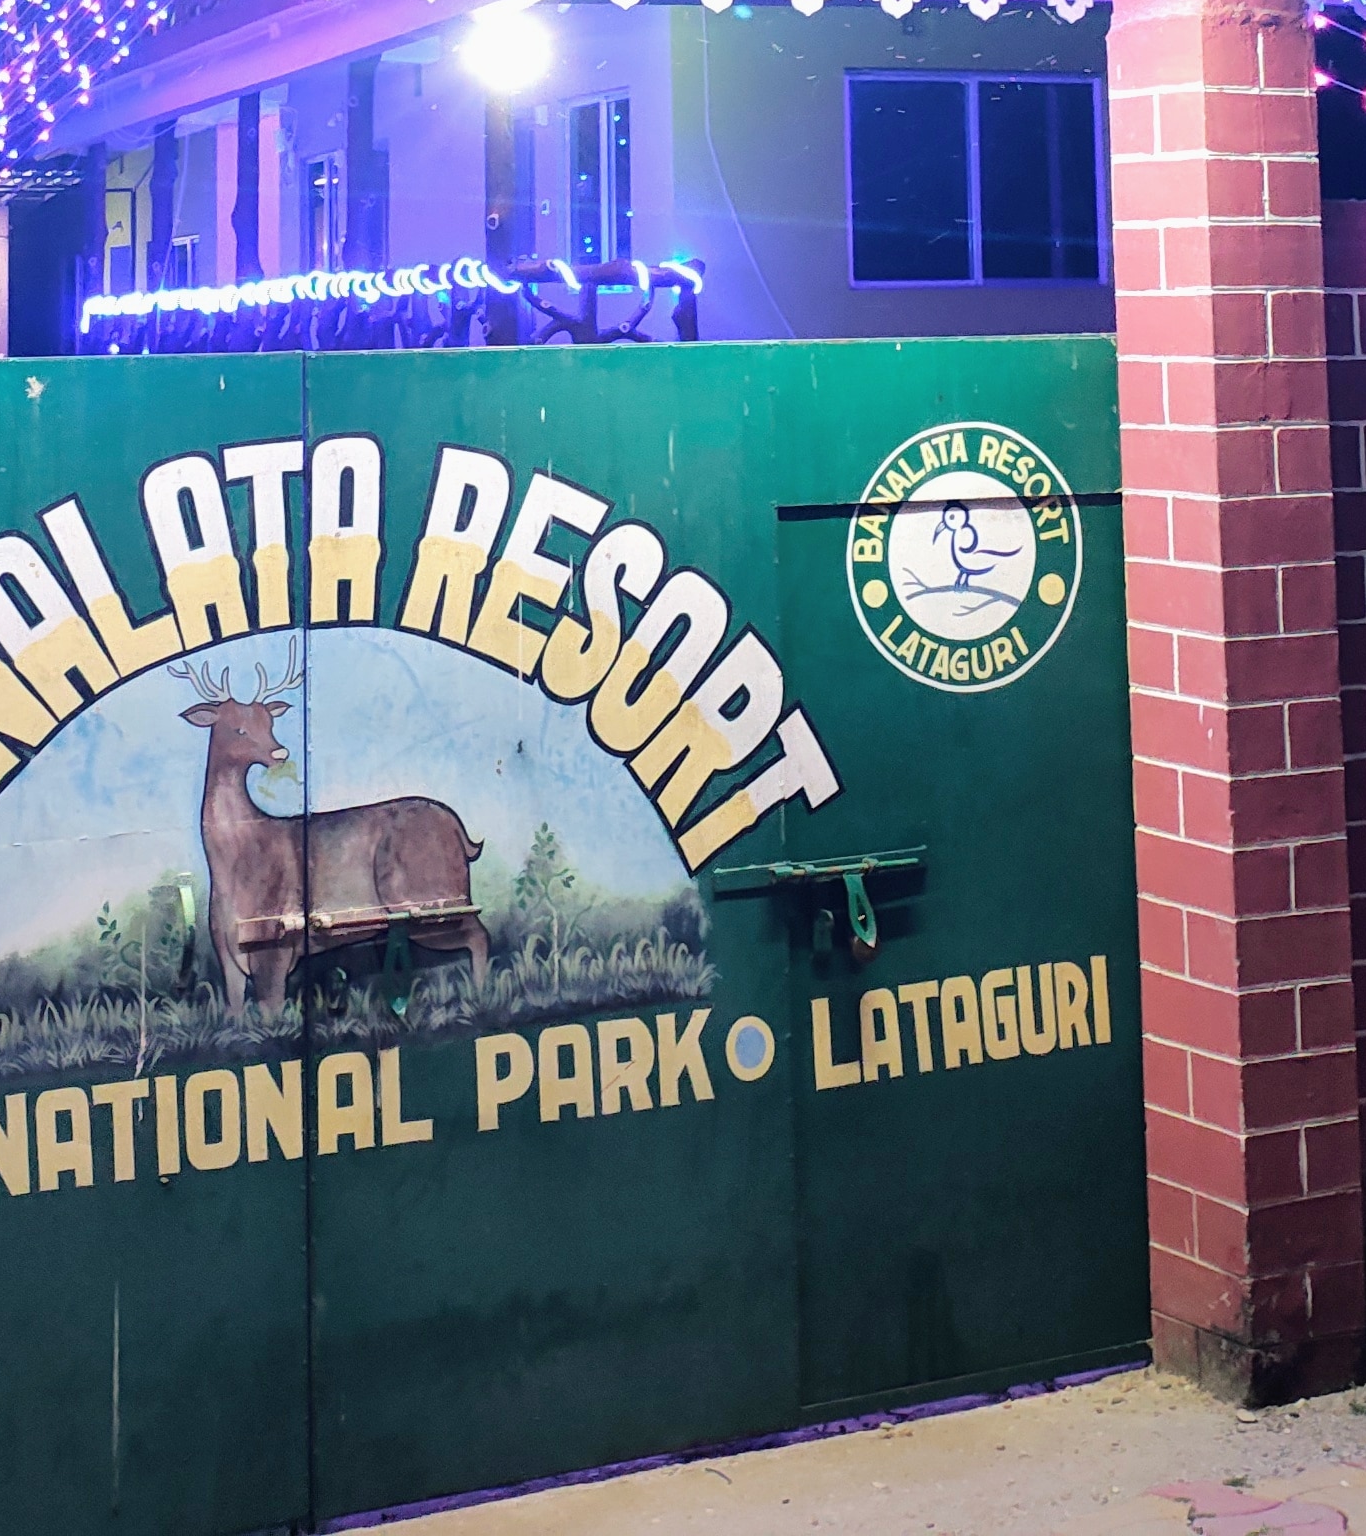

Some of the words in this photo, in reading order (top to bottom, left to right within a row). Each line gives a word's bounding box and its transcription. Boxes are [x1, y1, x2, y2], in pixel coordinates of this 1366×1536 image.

[854, 432, 968, 562] BANALATA
[978, 435, 1069, 544] RESORT
[403, 444, 844, 874] RESORT
[879, 615, 1029, 681] LATAGURI
[475, 1008, 715, 1132] PARK
[812, 955, 1112, 1091] LATAGURI
